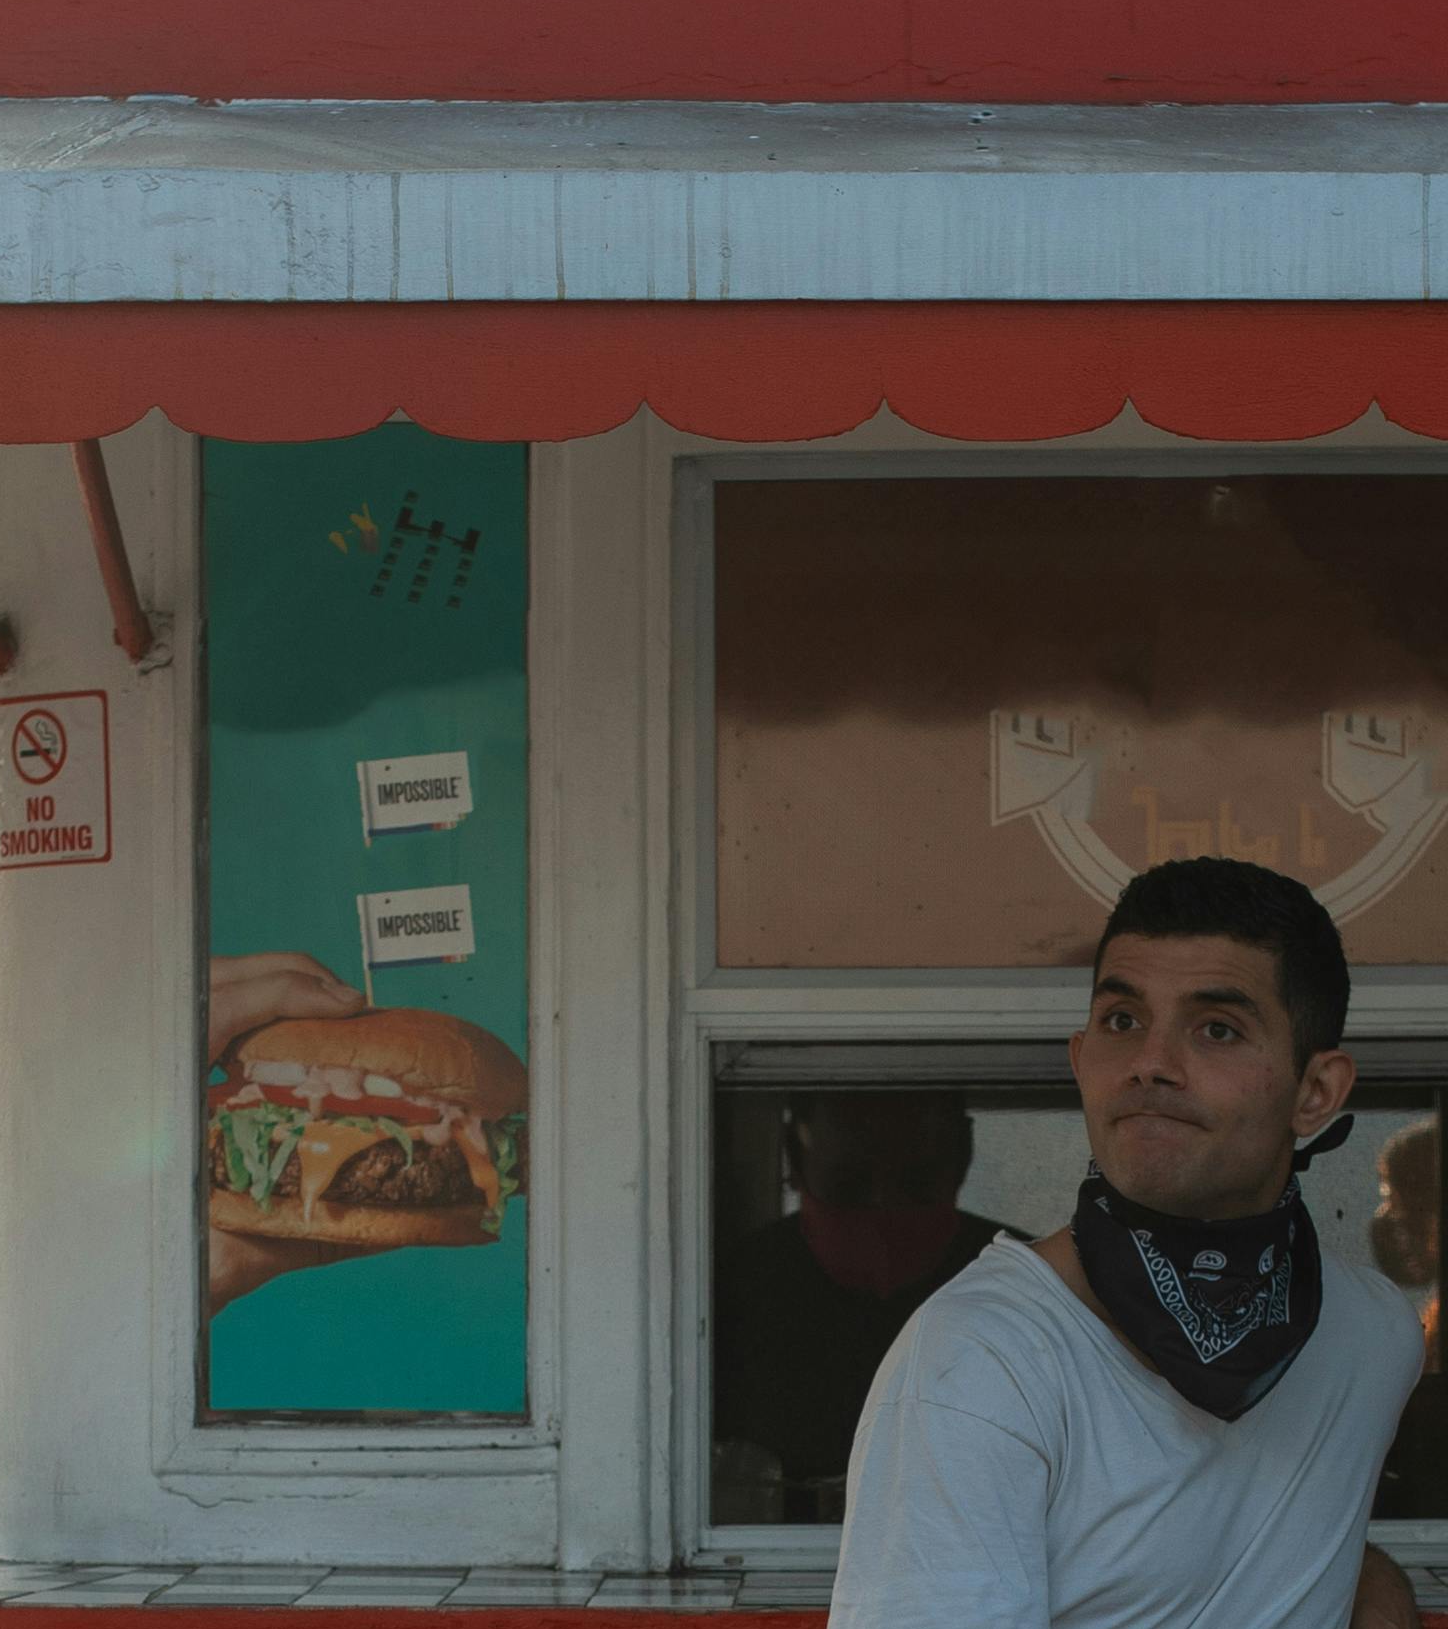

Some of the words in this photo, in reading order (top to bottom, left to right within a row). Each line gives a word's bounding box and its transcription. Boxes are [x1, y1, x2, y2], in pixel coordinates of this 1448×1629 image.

[377, 776, 460, 806] IMPOSSIBLE
[26, 795, 55, 822] NO
[0, 825, 93, 857] SMOKING
[377, 910, 462, 939] IMPOSSIBLE
